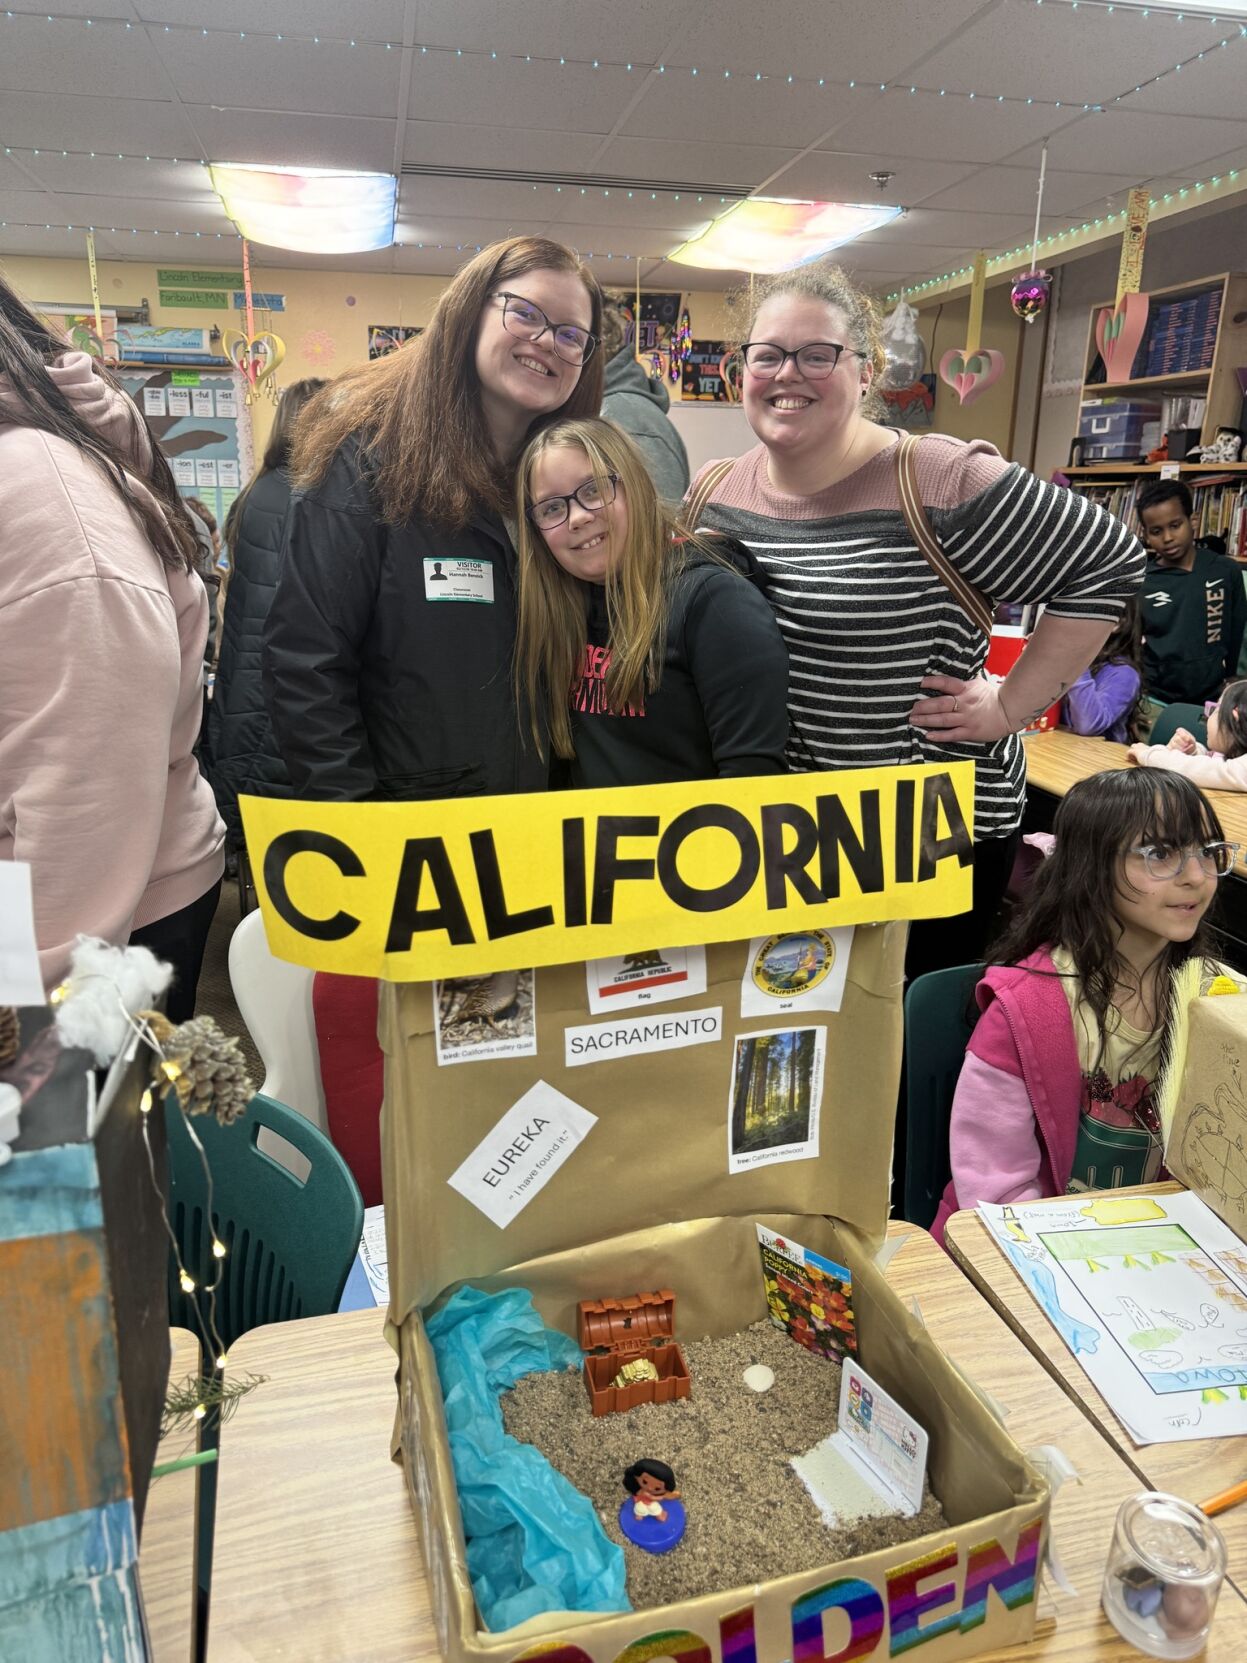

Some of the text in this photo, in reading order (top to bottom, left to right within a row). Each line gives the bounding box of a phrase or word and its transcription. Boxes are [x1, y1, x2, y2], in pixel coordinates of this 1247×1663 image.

[698, 376, 722, 393] YET
[1206, 588, 1225, 644] NIKE
[263, 772, 974, 953] CALIFORNIA
[613, 966, 672, 983] CALIFORNIA REPUBLIC
[767, 984, 810, 995] CALIFORNIA
[570, 1017, 717, 1054] SACRAMENTO
[443, 1052, 459, 1060] bird:
[461, 1047, 495, 1057] California
[496, 1044, 515, 1053] valley
[482, 1117, 551, 1188] EUREKA
[517, 1169, 538, 1192] have
[535, 1143, 560, 1170] found
[737, 1147, 804, 1165] tree: California redwood
[763, 1248, 808, 1279] CALIFORNIA
[764, 1257, 788, 1274] POPPY
[512, 1518, 1044, 1663] LDEN
